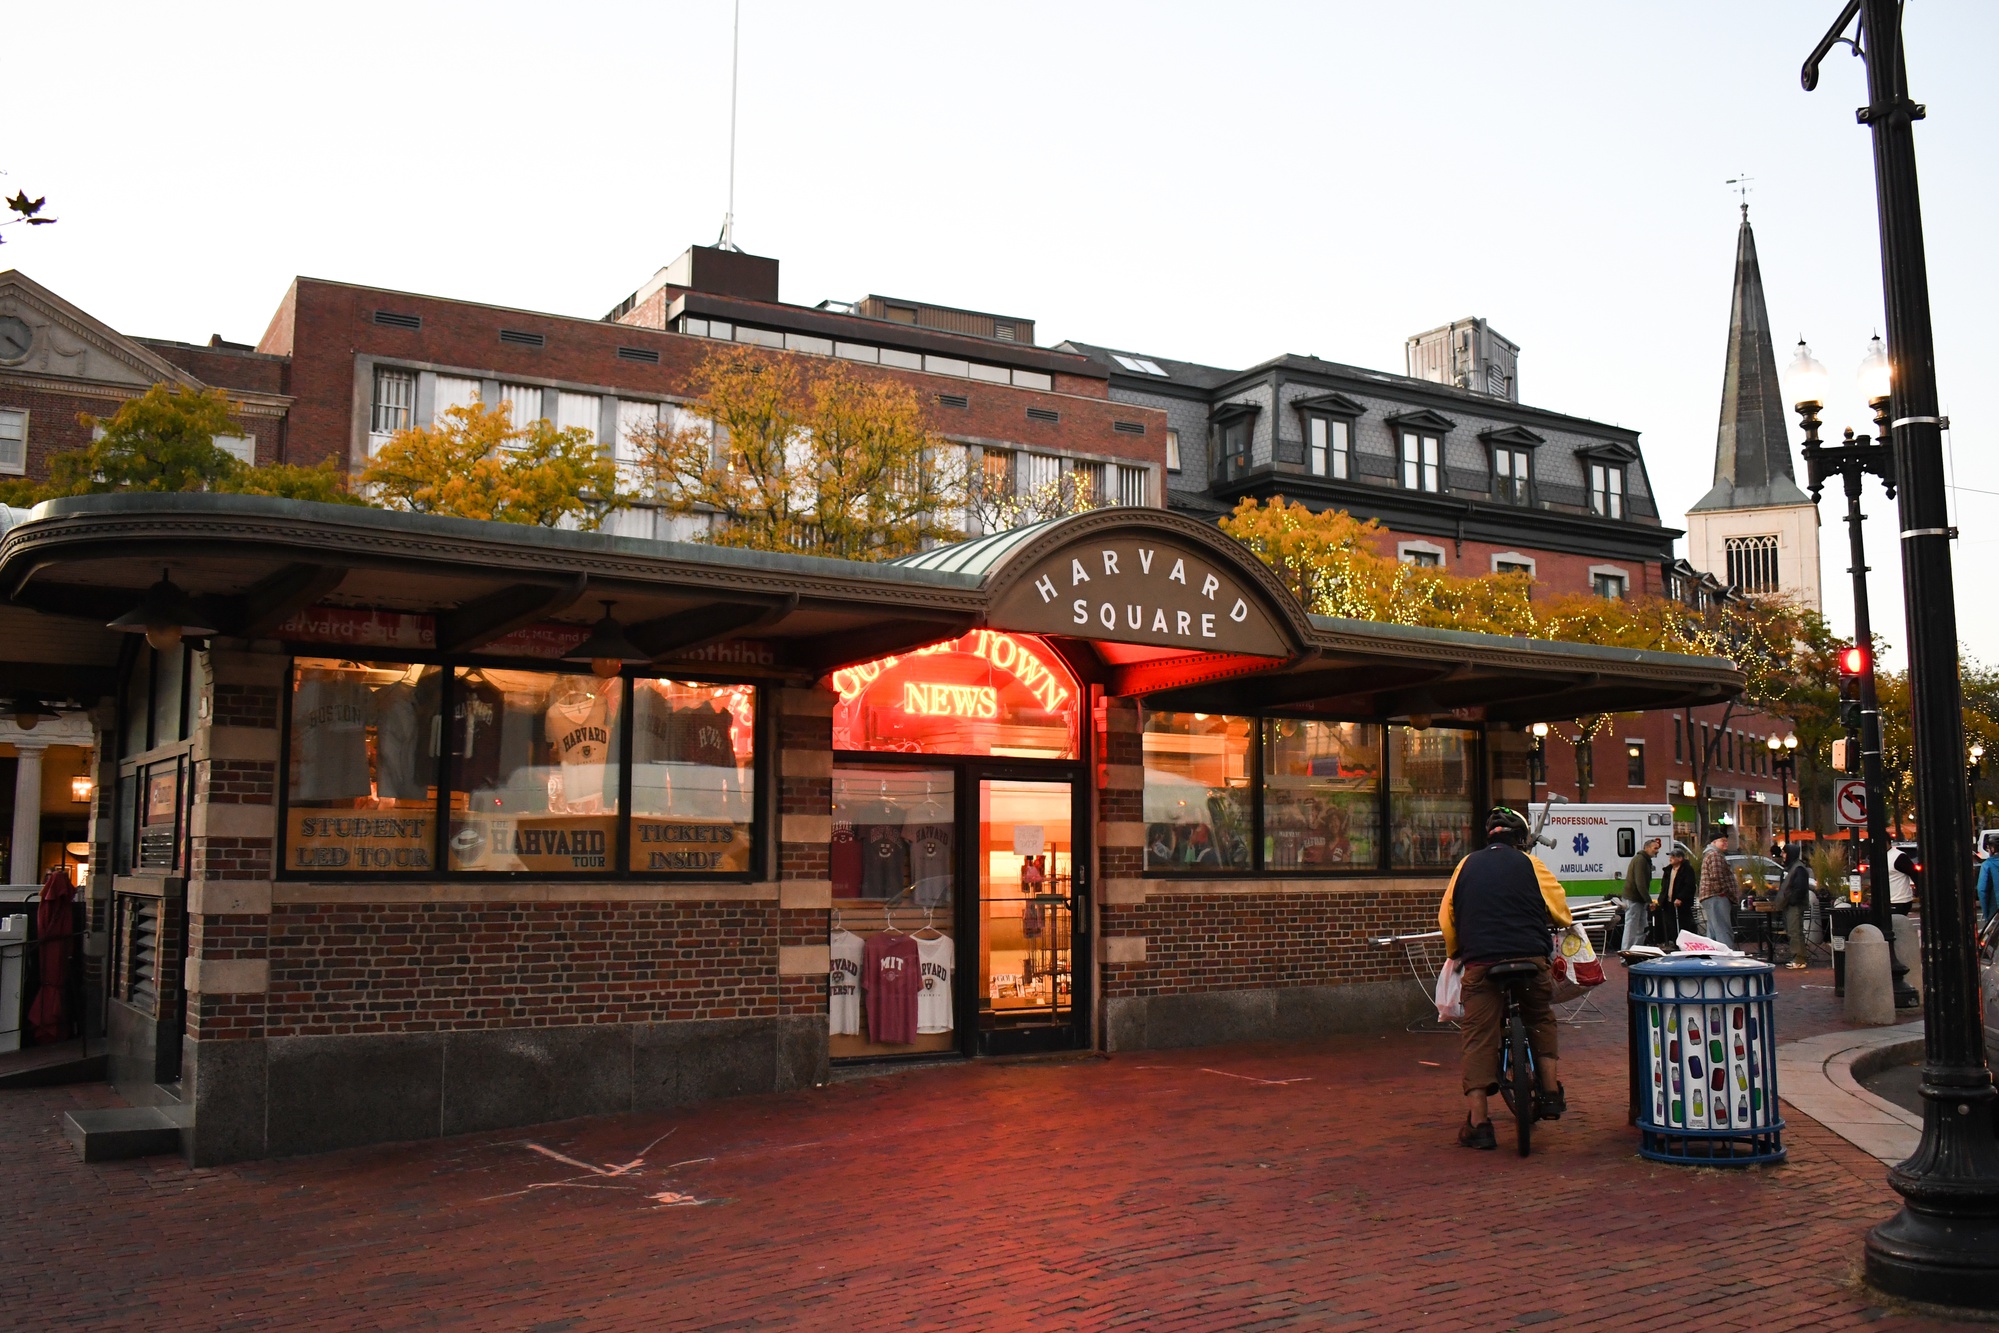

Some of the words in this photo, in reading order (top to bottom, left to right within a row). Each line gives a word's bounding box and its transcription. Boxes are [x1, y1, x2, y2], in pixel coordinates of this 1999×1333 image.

[1033, 547, 1248, 624] HARVARD
[1072, 599, 1217, 638] SQUARE
[971, 628, 1069, 714] TOWN
[904, 682, 997, 717] NEWS
[309, 703, 362, 728] BOSTON
[562, 726, 607, 753] HARVARD
[301, 817, 426, 838] STUDENT
[1551, 816, 1608, 826] PROFESSIONAL
[491, 828, 606, 855] HAHVAHD
[637, 823, 734, 843] TICKETS
[295, 846, 349, 867] LED
[355, 846, 432, 867] TOUR
[572, 855, 606, 868] TOUR
[648, 850, 724, 870] INSIDE
[1560, 863, 1604, 873] AMBULANCE
[880, 956, 904, 971] MIT
